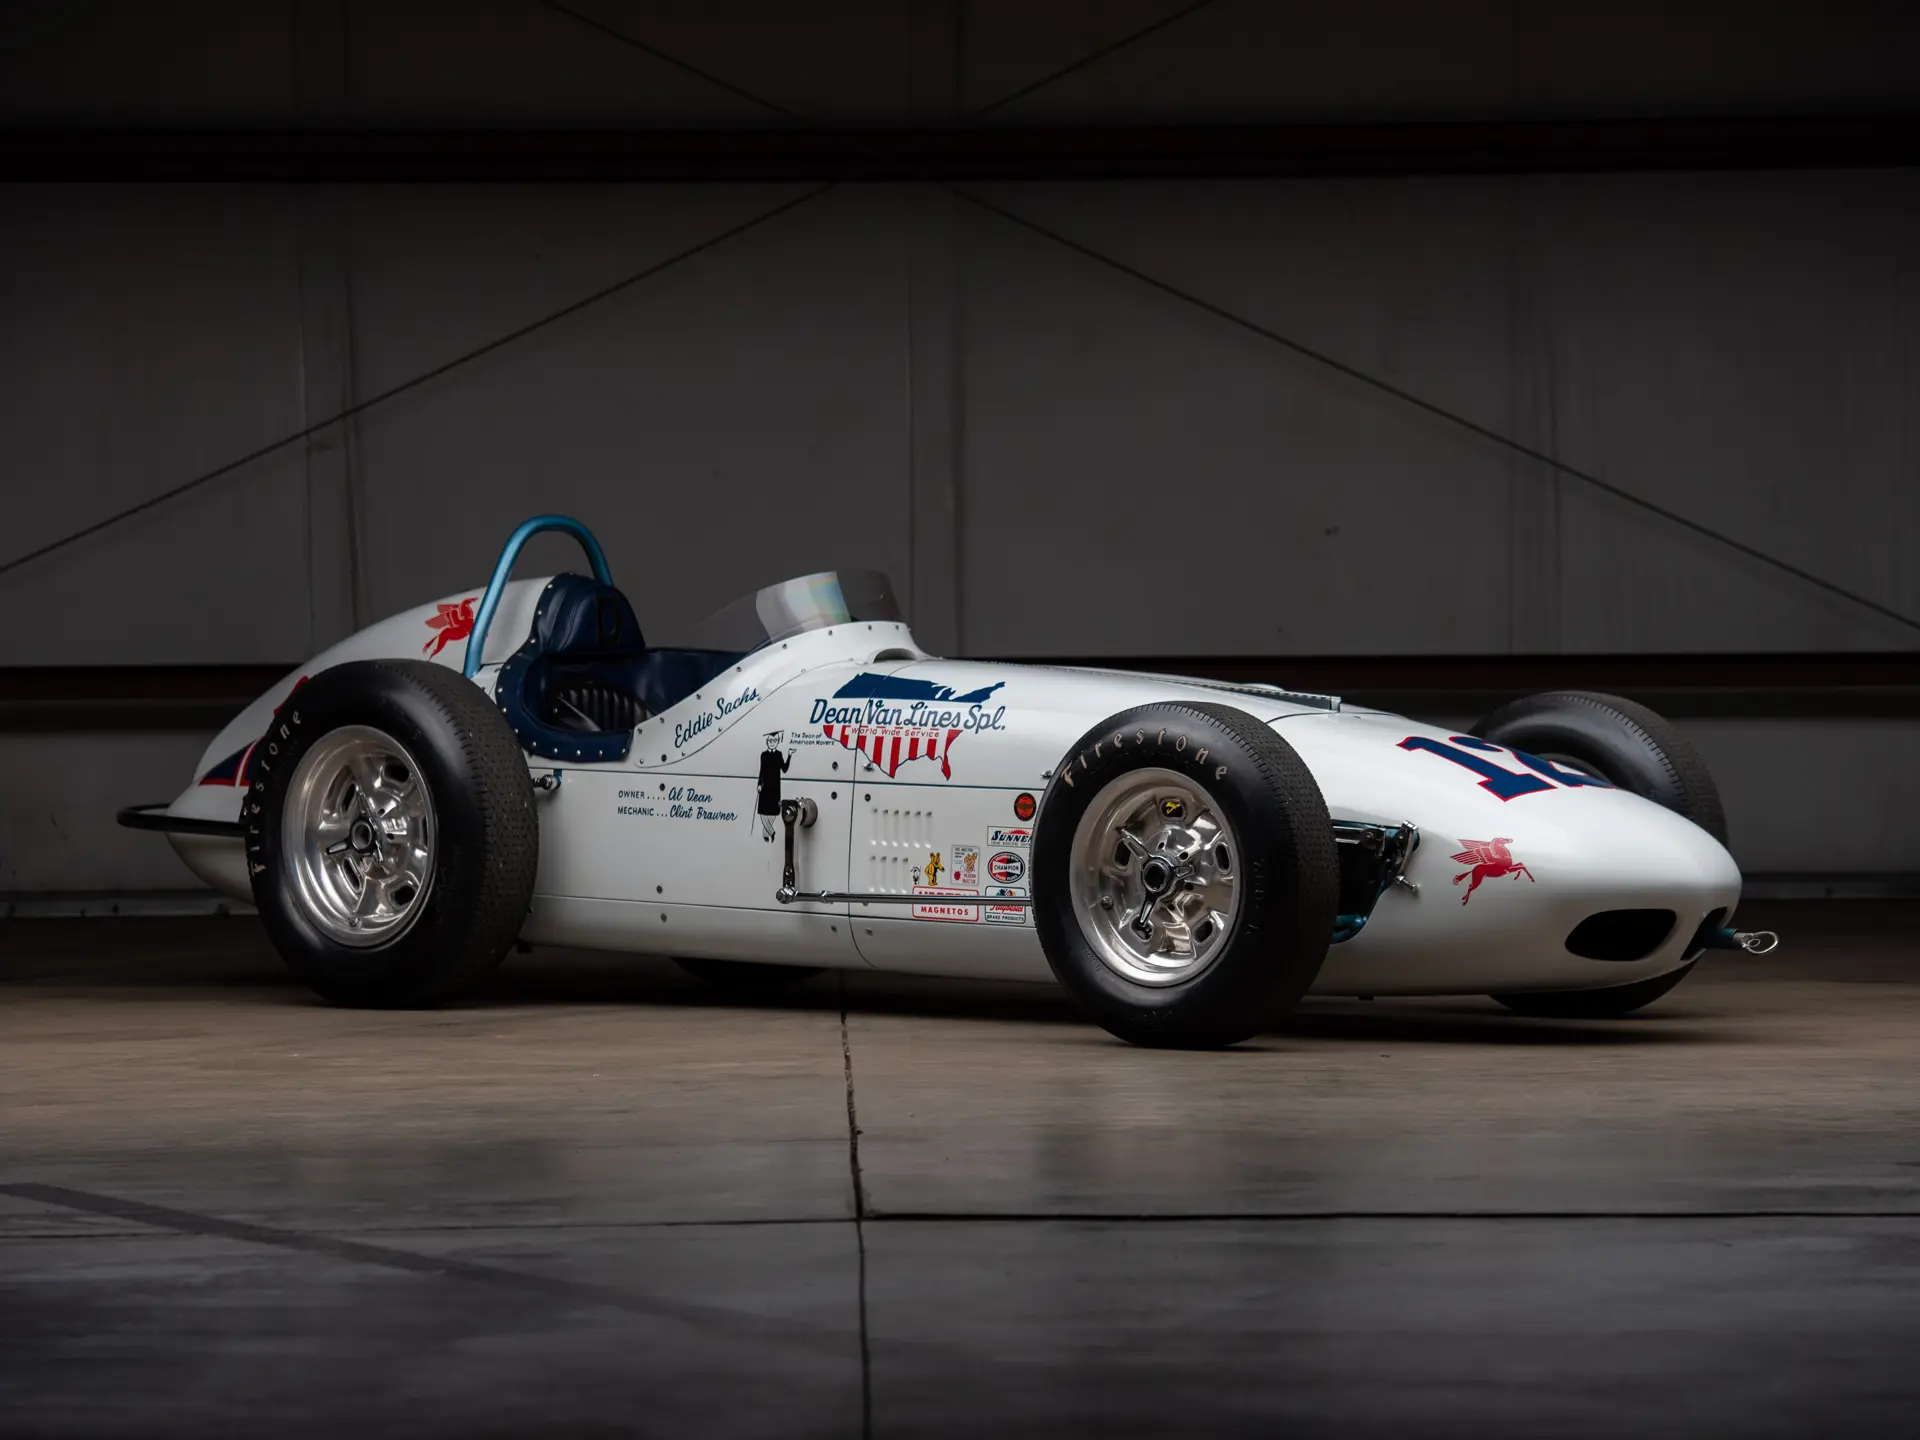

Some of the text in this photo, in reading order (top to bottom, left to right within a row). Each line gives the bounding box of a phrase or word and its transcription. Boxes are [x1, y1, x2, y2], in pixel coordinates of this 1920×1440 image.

[674, 687, 759, 748] Eddie Sachs
[809, 698, 1006, 733] Dean Van Lines Spl.
[851, 727, 940, 738] World Wide Service
[1061, 728, 1228, 788] Firestone
[250, 711, 302, 877] Firestone
[668, 786, 683, 801] Al
[686, 788, 713, 803] Dean
[669, 804, 694, 819] Clint
[696, 807, 738, 821] Brawner
[920, 906, 969, 916] MAGNETOS
